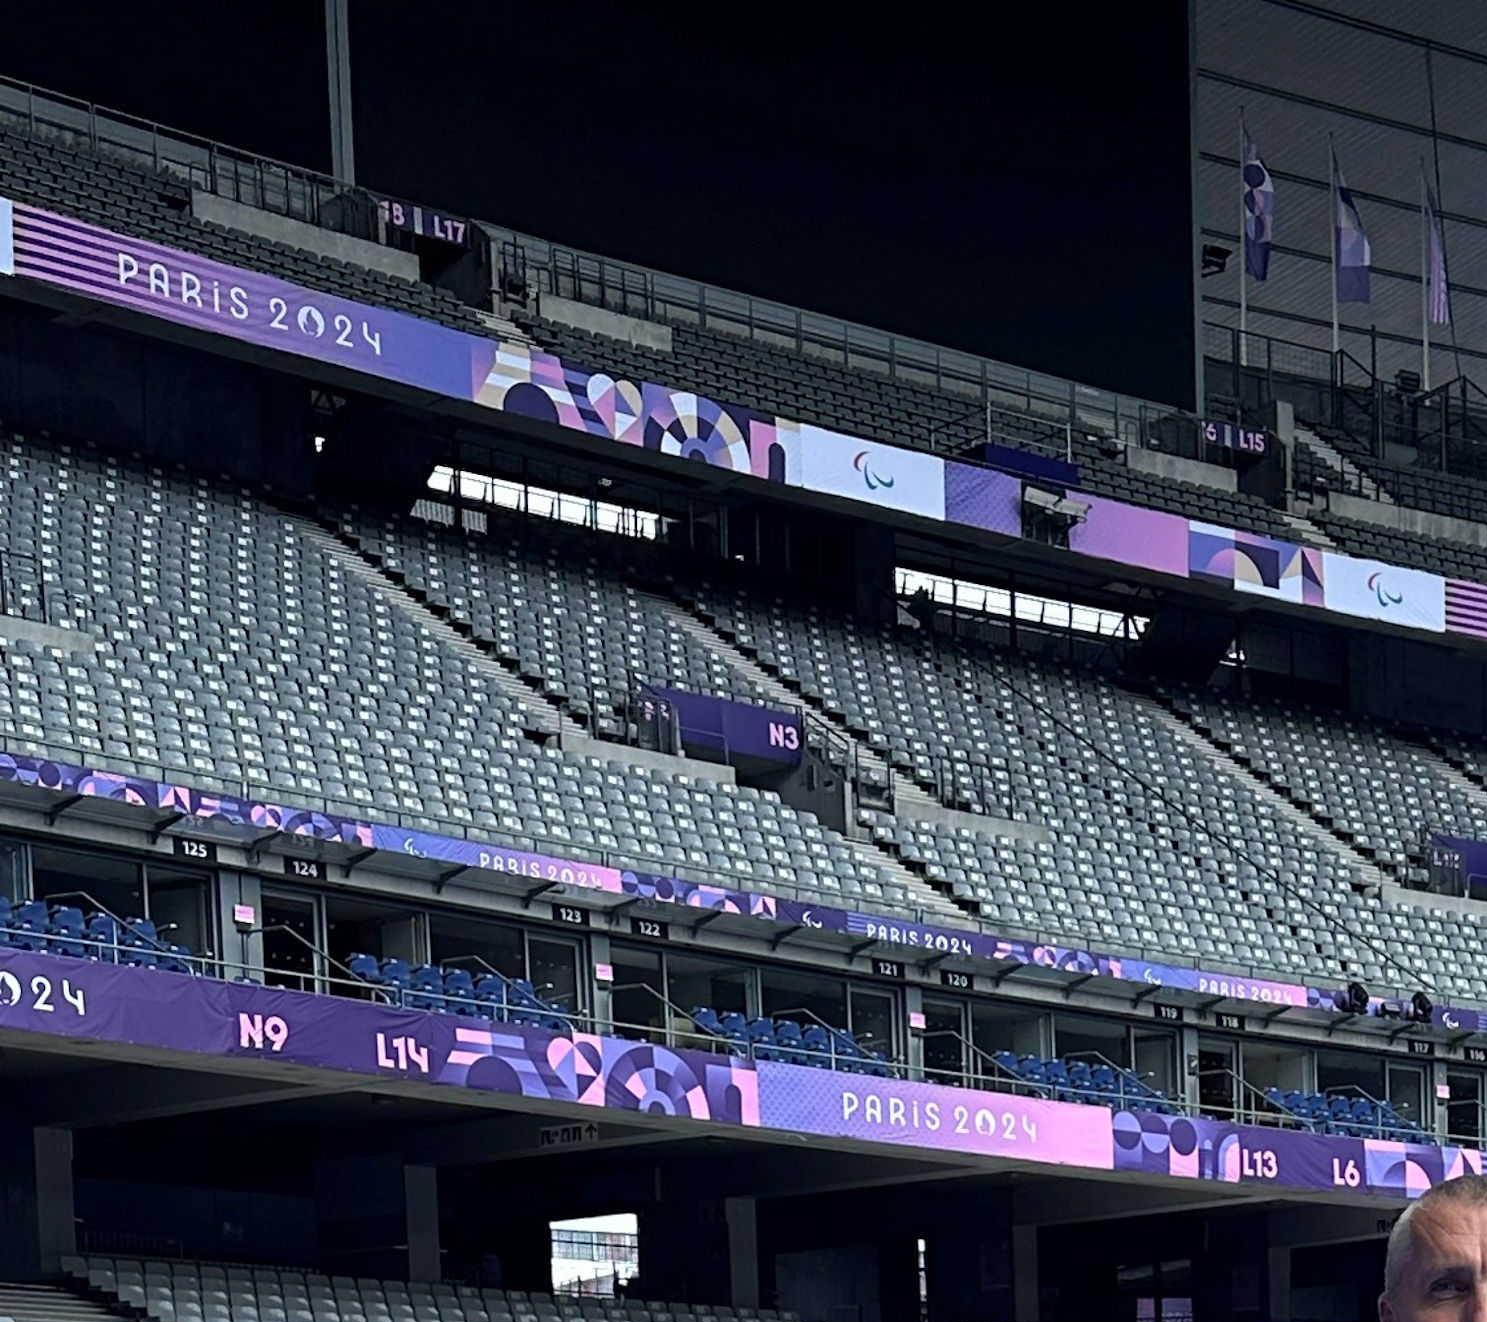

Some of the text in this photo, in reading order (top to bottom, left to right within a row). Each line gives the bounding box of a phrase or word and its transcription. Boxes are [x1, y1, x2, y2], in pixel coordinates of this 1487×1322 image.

[433, 214, 465, 243] L17
[269, 297, 382, 355] 2024
[1239, 428, 1265, 453] L15
[768, 722, 799, 750] N3
[181, 840, 208, 859] 125
[292, 860, 318, 879] 124
[547, 864, 603, 889] 2024
[560, 907, 583, 924] 123
[639, 920, 661, 937] 122
[924, 933, 973, 956] 2024
[878, 962, 898, 977] 121
[948, 972, 968, 988] 120
[1160, 1005, 1178, 1020] 119
[238, 1012, 289, 1052] N9
[376, 1032, 429, 1073] L14
[953, 1105, 1037, 1143] 2024
[1242, 1148, 1278, 1178] L13
[1332, 1158, 1361, 1188] L6
